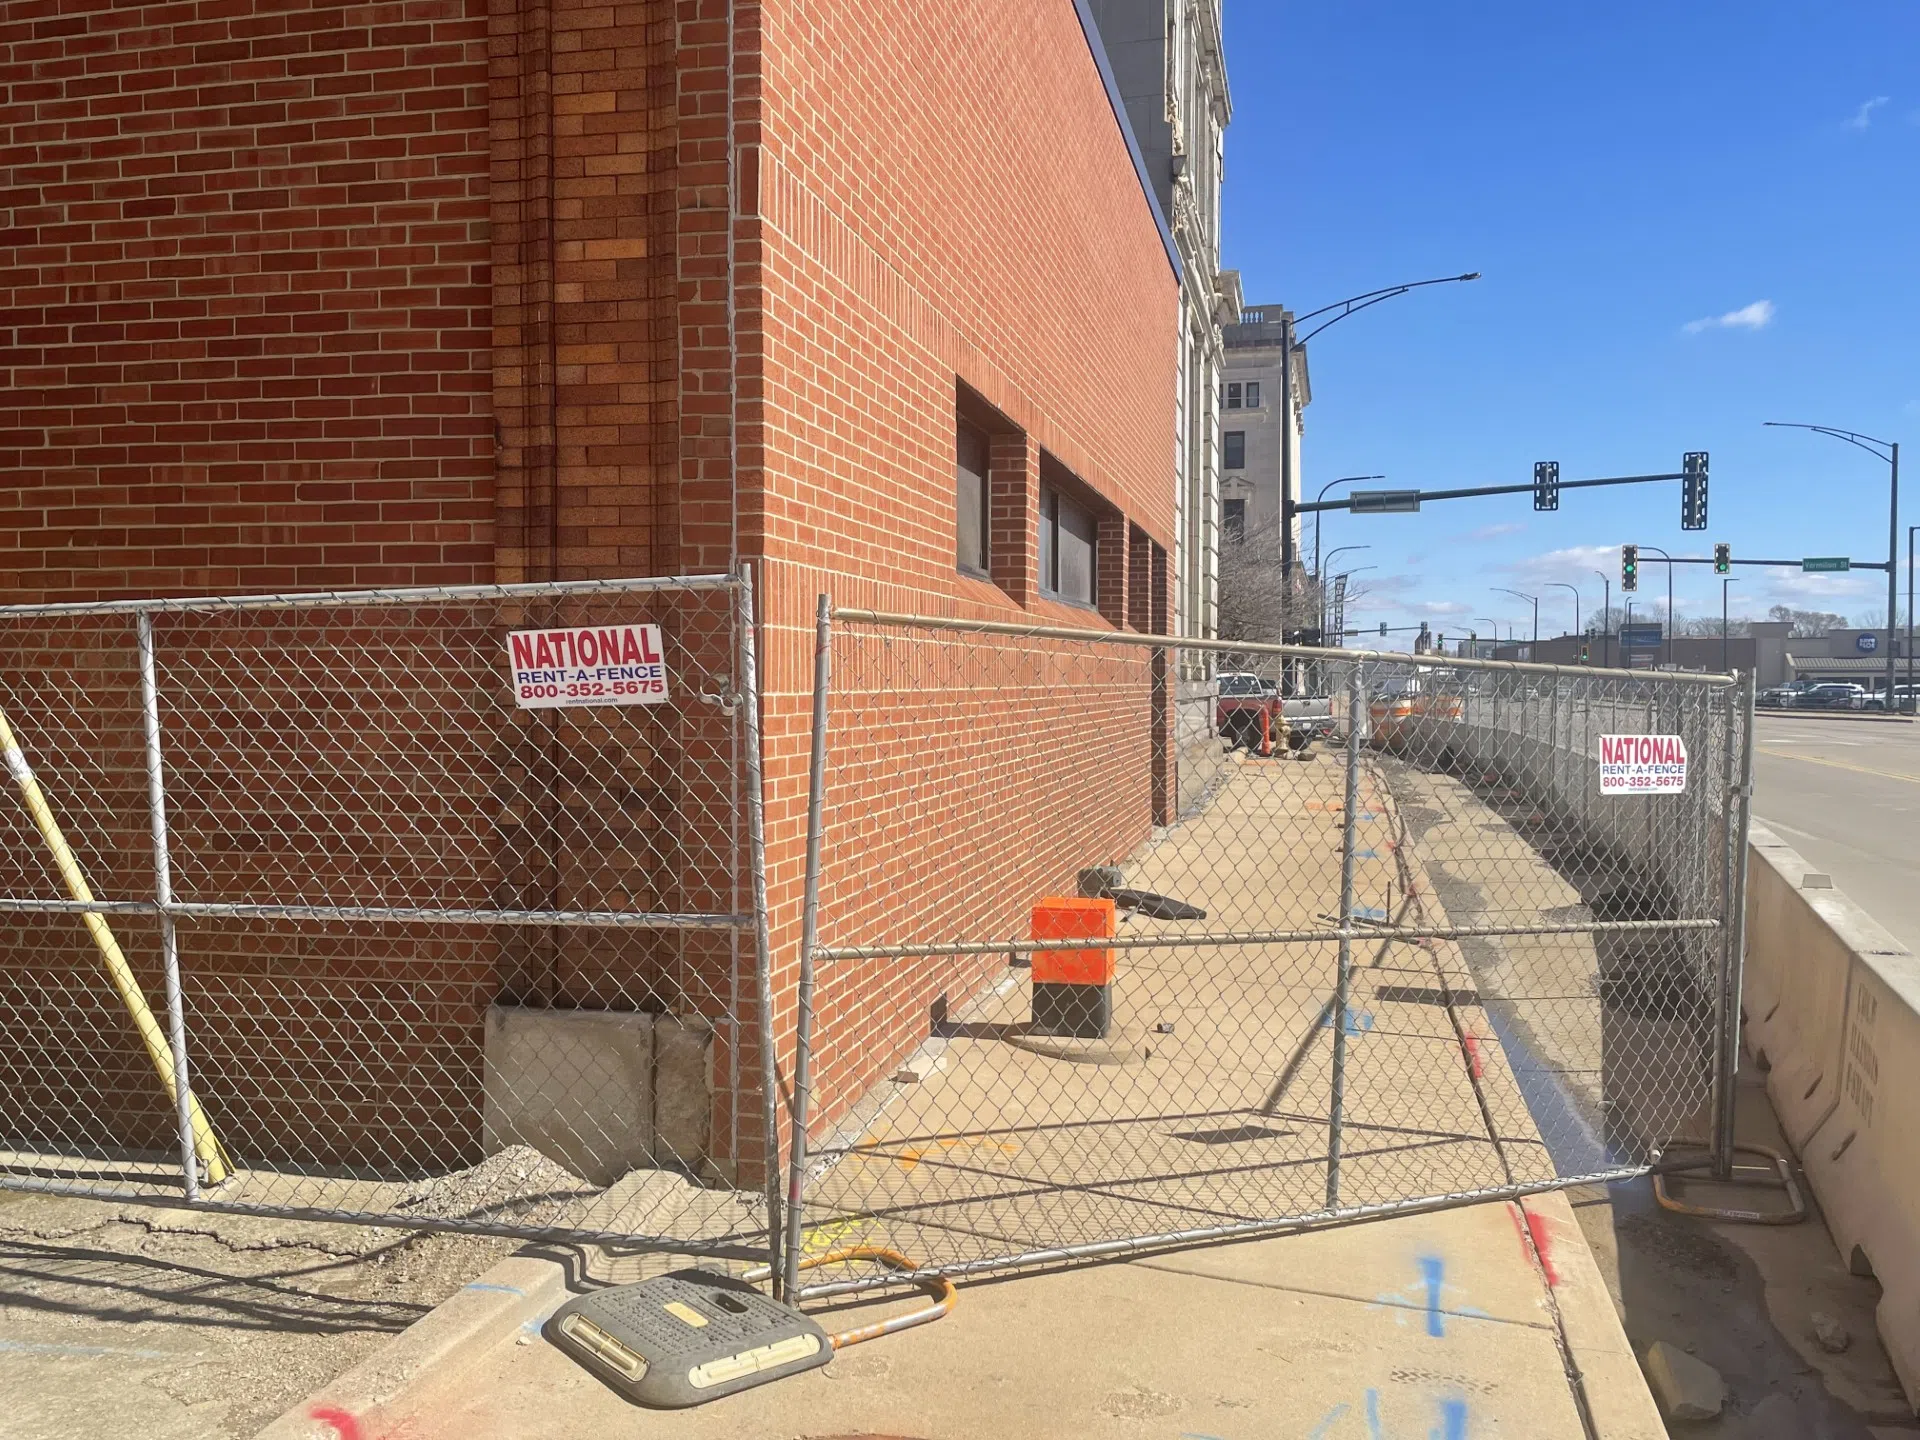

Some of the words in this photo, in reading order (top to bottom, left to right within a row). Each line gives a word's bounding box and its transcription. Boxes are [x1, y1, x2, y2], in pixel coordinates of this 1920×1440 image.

[511, 627, 660, 670] NATIONAL
[517, 665, 663, 684] RENT-A-FENCE
[520, 679, 664, 699] 800-352-5675
[1602, 737, 1685, 764] NATIONAL
[1602, 765, 1685, 775] RENT-A-FENCE
[1603, 776, 1684, 787] 800-352-5675
